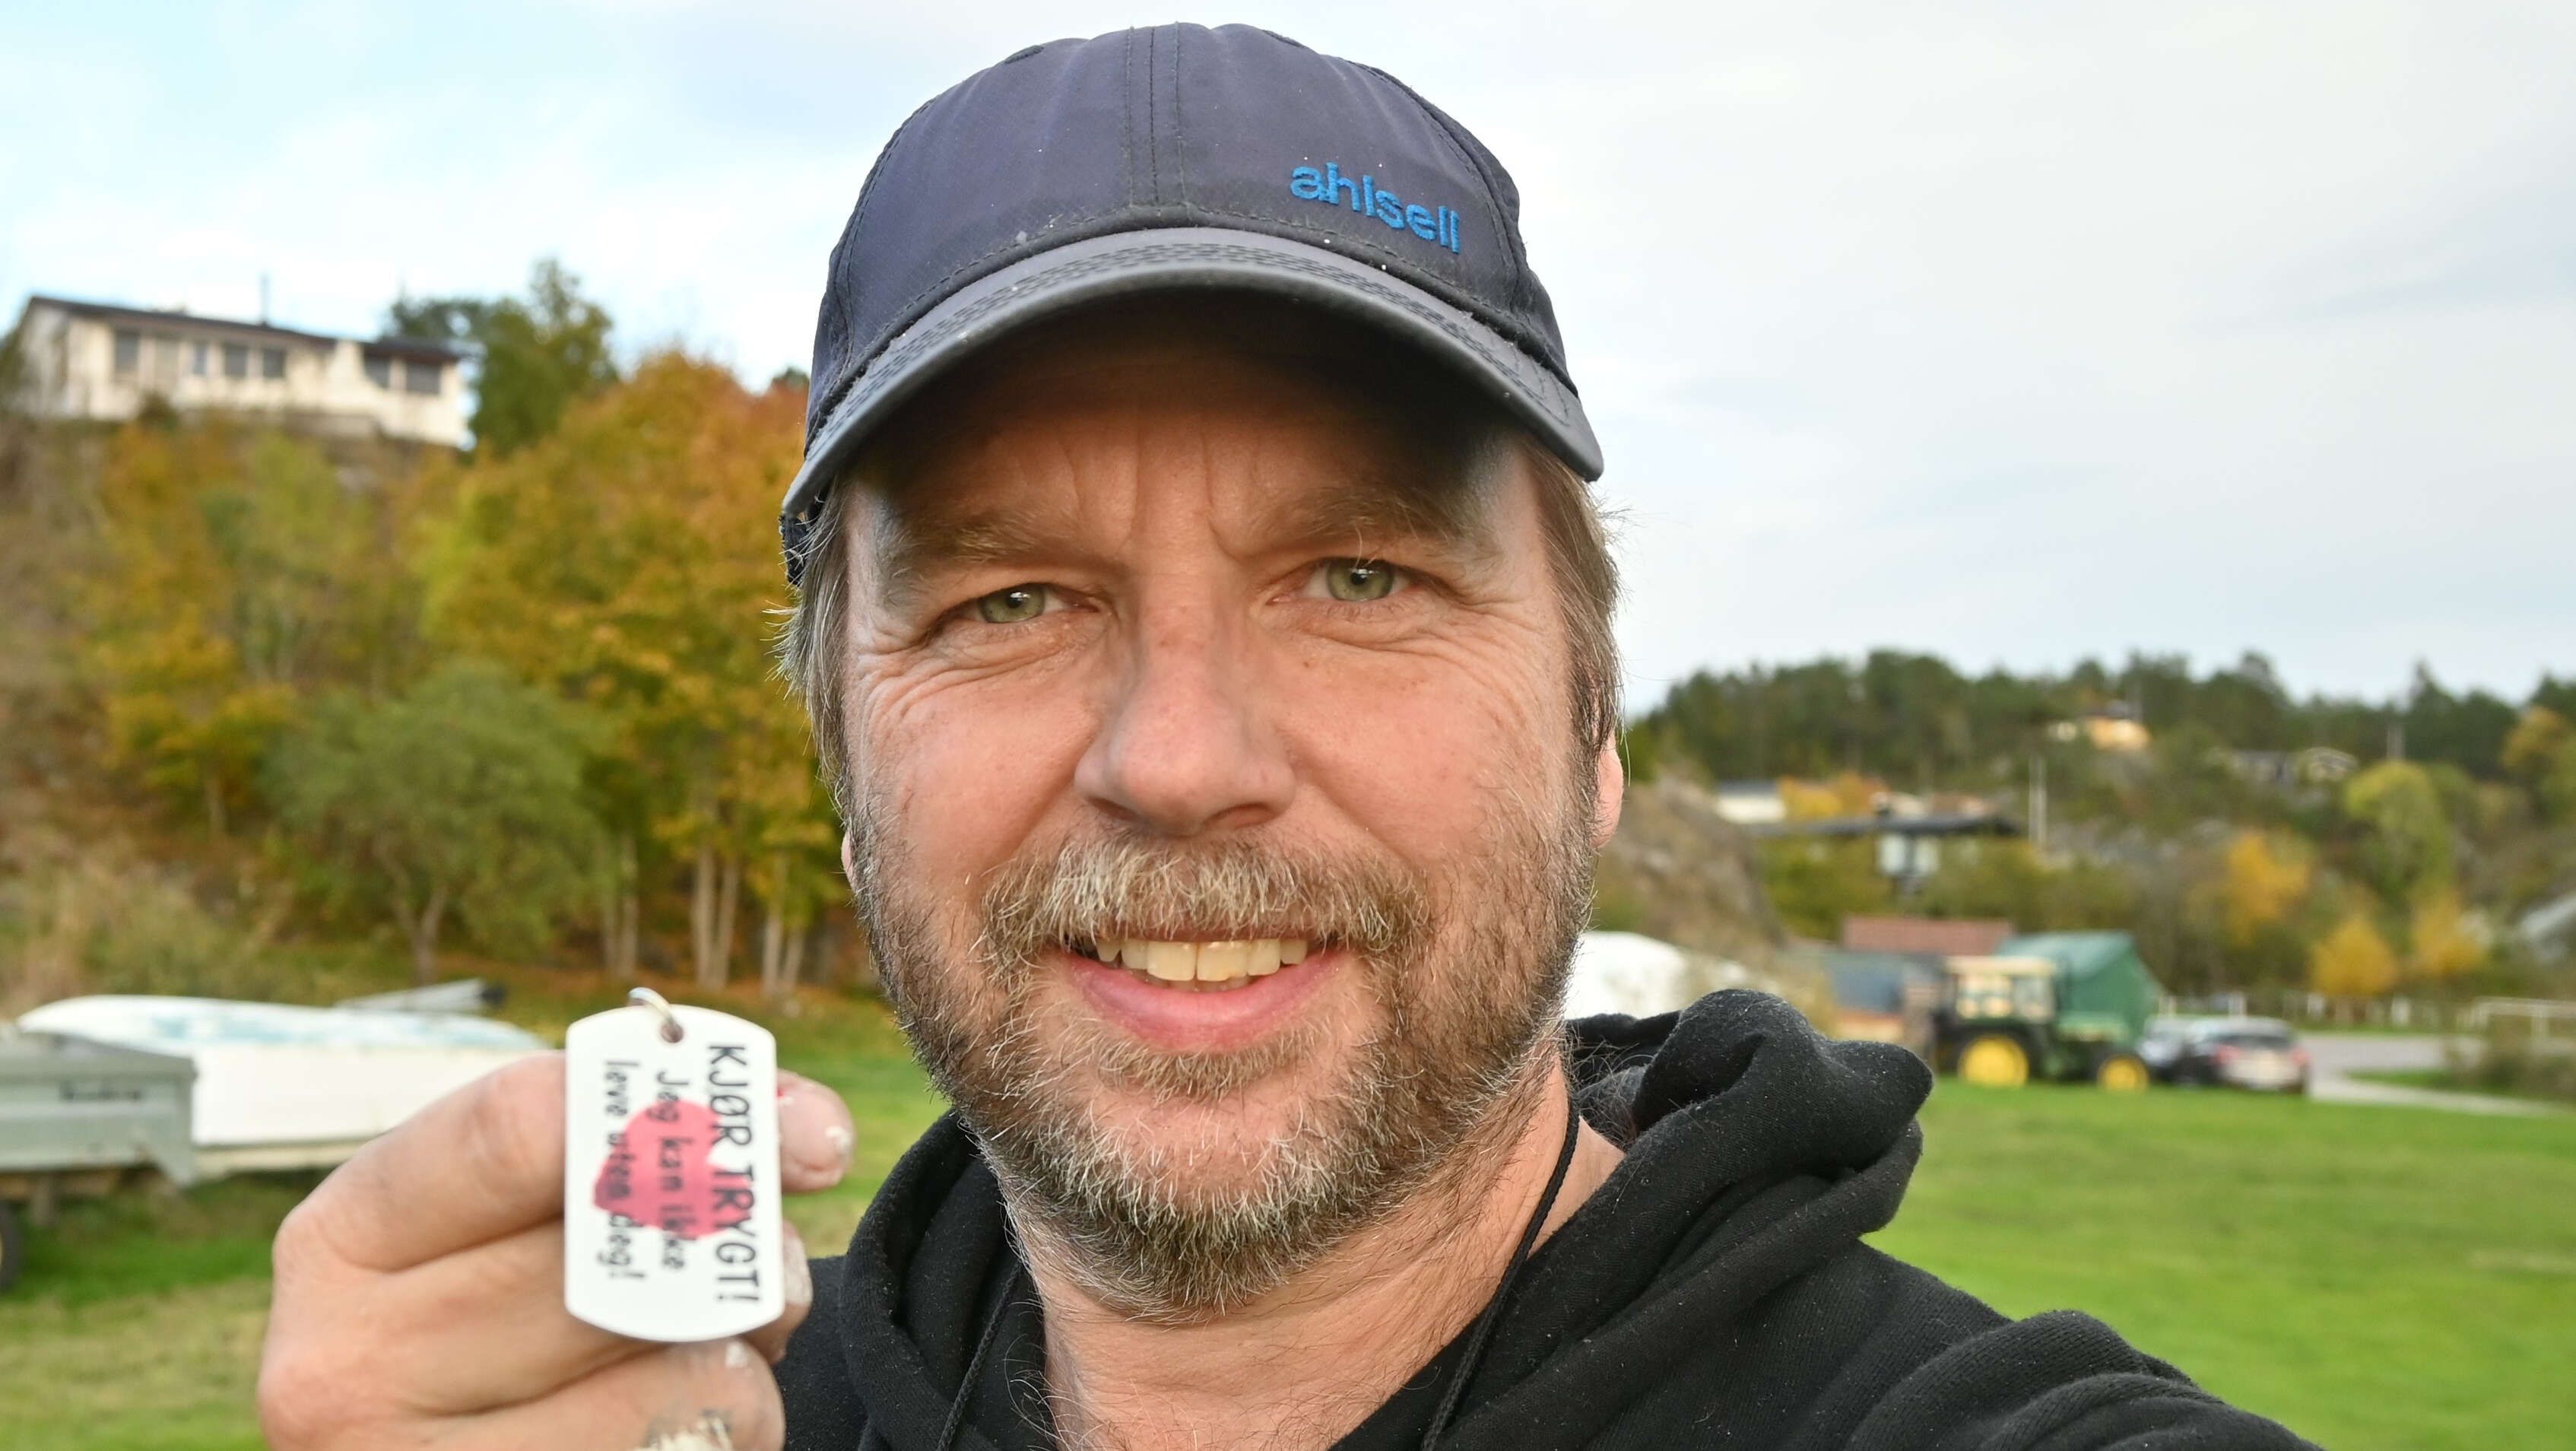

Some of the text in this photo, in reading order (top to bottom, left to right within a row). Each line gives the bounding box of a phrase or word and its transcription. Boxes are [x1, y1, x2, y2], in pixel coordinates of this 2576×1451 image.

[1290, 162, 1460, 254] ahlsell
[597, 1061, 646, 1279] leve uten deg!
[646, 1070, 697, 1270] Jeg kan ikke
[708, 1045, 760, 1301] KJØR TRYGT!
